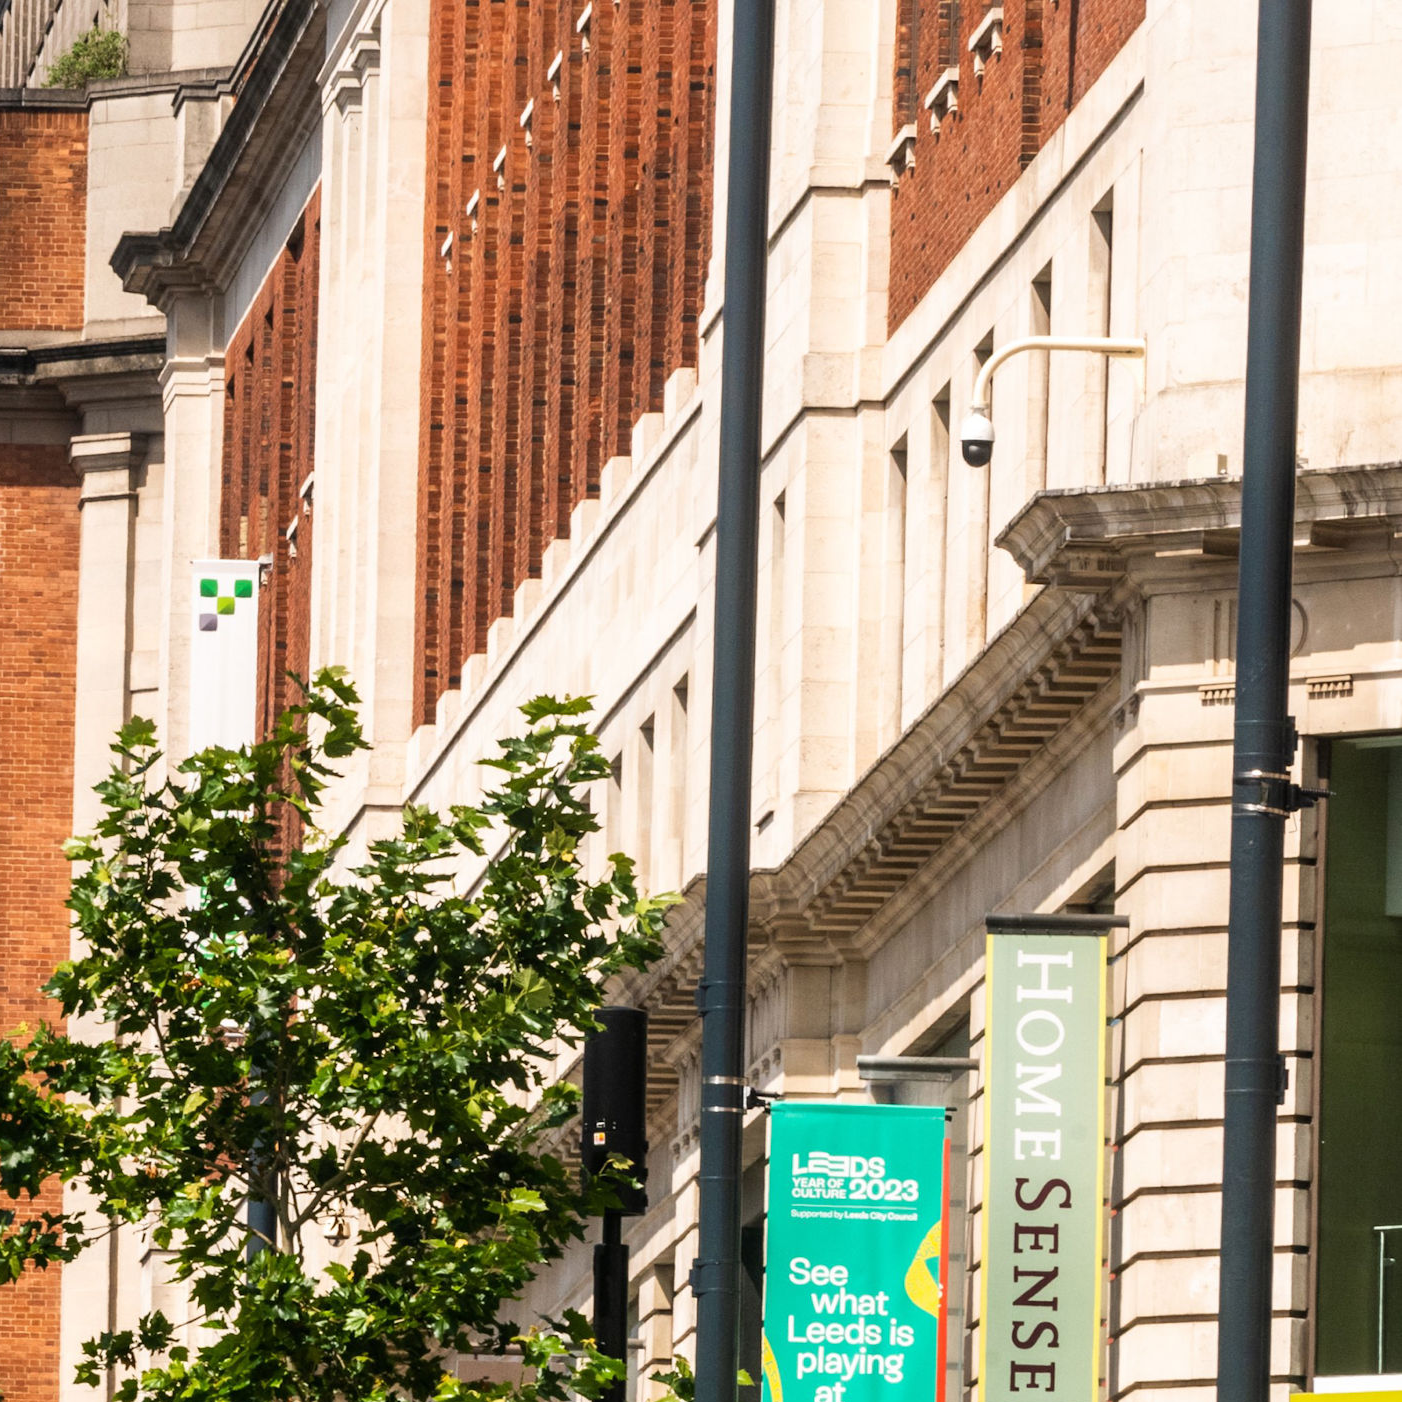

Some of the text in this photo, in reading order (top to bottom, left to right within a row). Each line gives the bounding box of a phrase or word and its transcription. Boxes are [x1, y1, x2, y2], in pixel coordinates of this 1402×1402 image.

[1014, 950, 1074, 1161] HOME
[792, 1151, 886, 1178] LEEDS
[791, 1188, 847, 1200] CULTURE
[792, 1177, 845, 1188] YEAR OF
[848, 1178, 920, 1202] 2023
[790, 1208, 918, 1222] Supported by Leeds City Council
[788, 1256, 849, 1286] See
[1010, 1177, 1072, 1392] SENSE
[810, 1286, 890, 1316] what
[787, 1314, 914, 1347] Leeds is
[796, 1345, 905, 1384] playing
